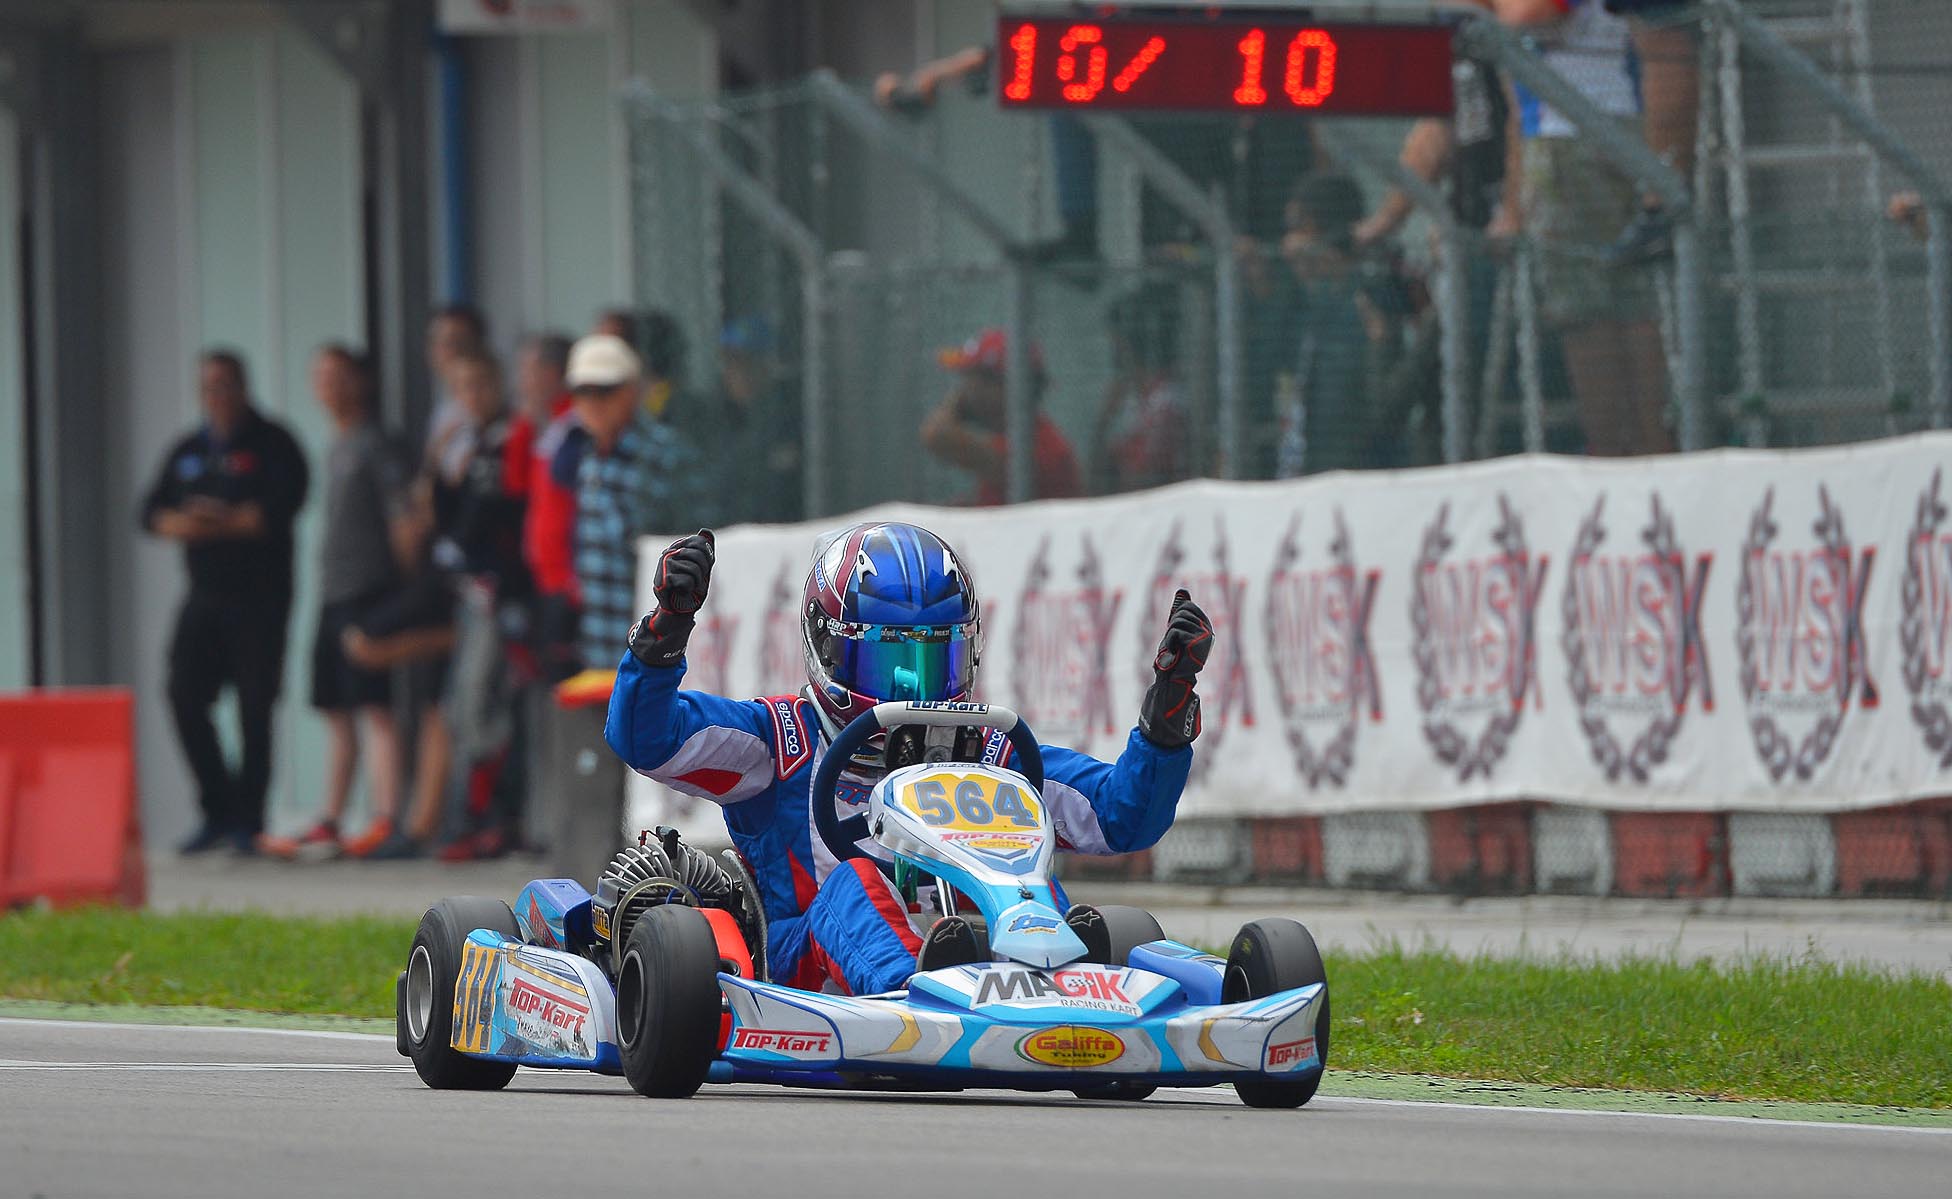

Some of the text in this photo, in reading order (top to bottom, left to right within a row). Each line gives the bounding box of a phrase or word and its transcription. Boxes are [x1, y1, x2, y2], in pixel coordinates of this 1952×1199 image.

[1233, 28, 1336, 106] 10
[1422, 550, 1550, 713] WSK
[1576, 551, 1715, 715] WSK
[1750, 543, 1880, 711] WSK
[914, 780, 1039, 828] 564
[451, 947, 501, 1050] 564
[976, 970, 1131, 1004] MAGIK
[1061, 999, 1139, 1015] RACING KART
[1036, 1036, 1116, 1051] Galiffa
